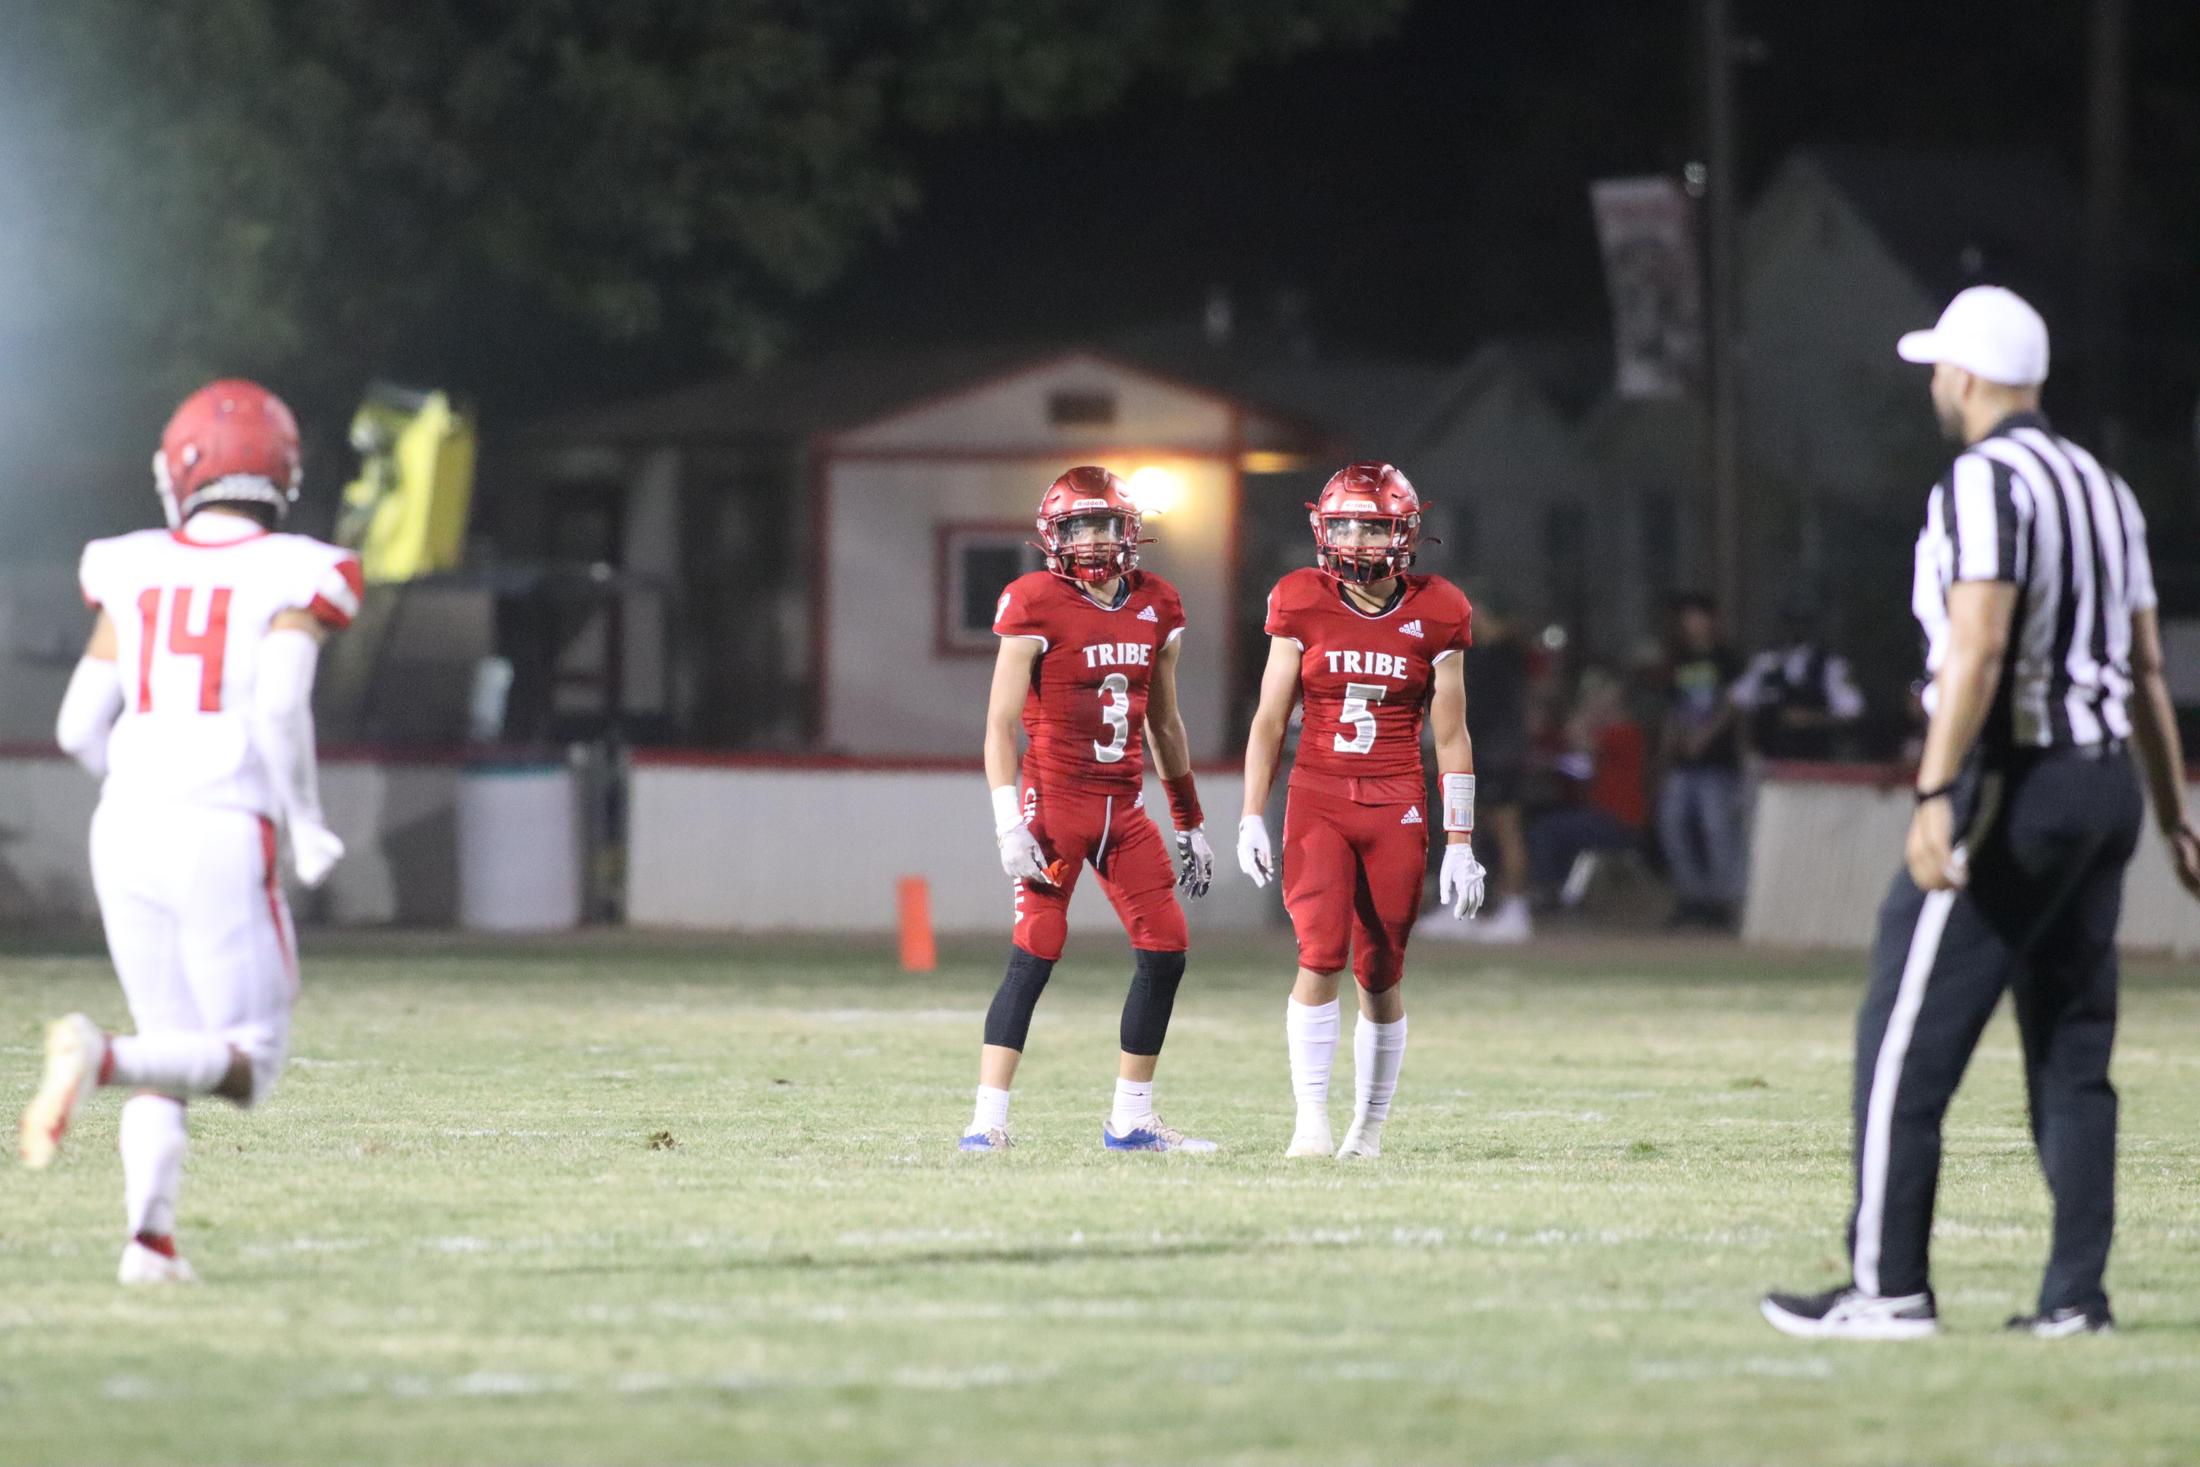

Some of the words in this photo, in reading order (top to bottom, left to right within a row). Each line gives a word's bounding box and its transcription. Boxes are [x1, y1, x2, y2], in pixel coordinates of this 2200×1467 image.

[136, 587, 233, 713] 14
[1082, 642, 1152, 668] TRIBE
[1325, 650, 1408, 680] TRIBE
[1093, 672, 1130, 764] 3
[1333, 682, 1388, 755] 5
